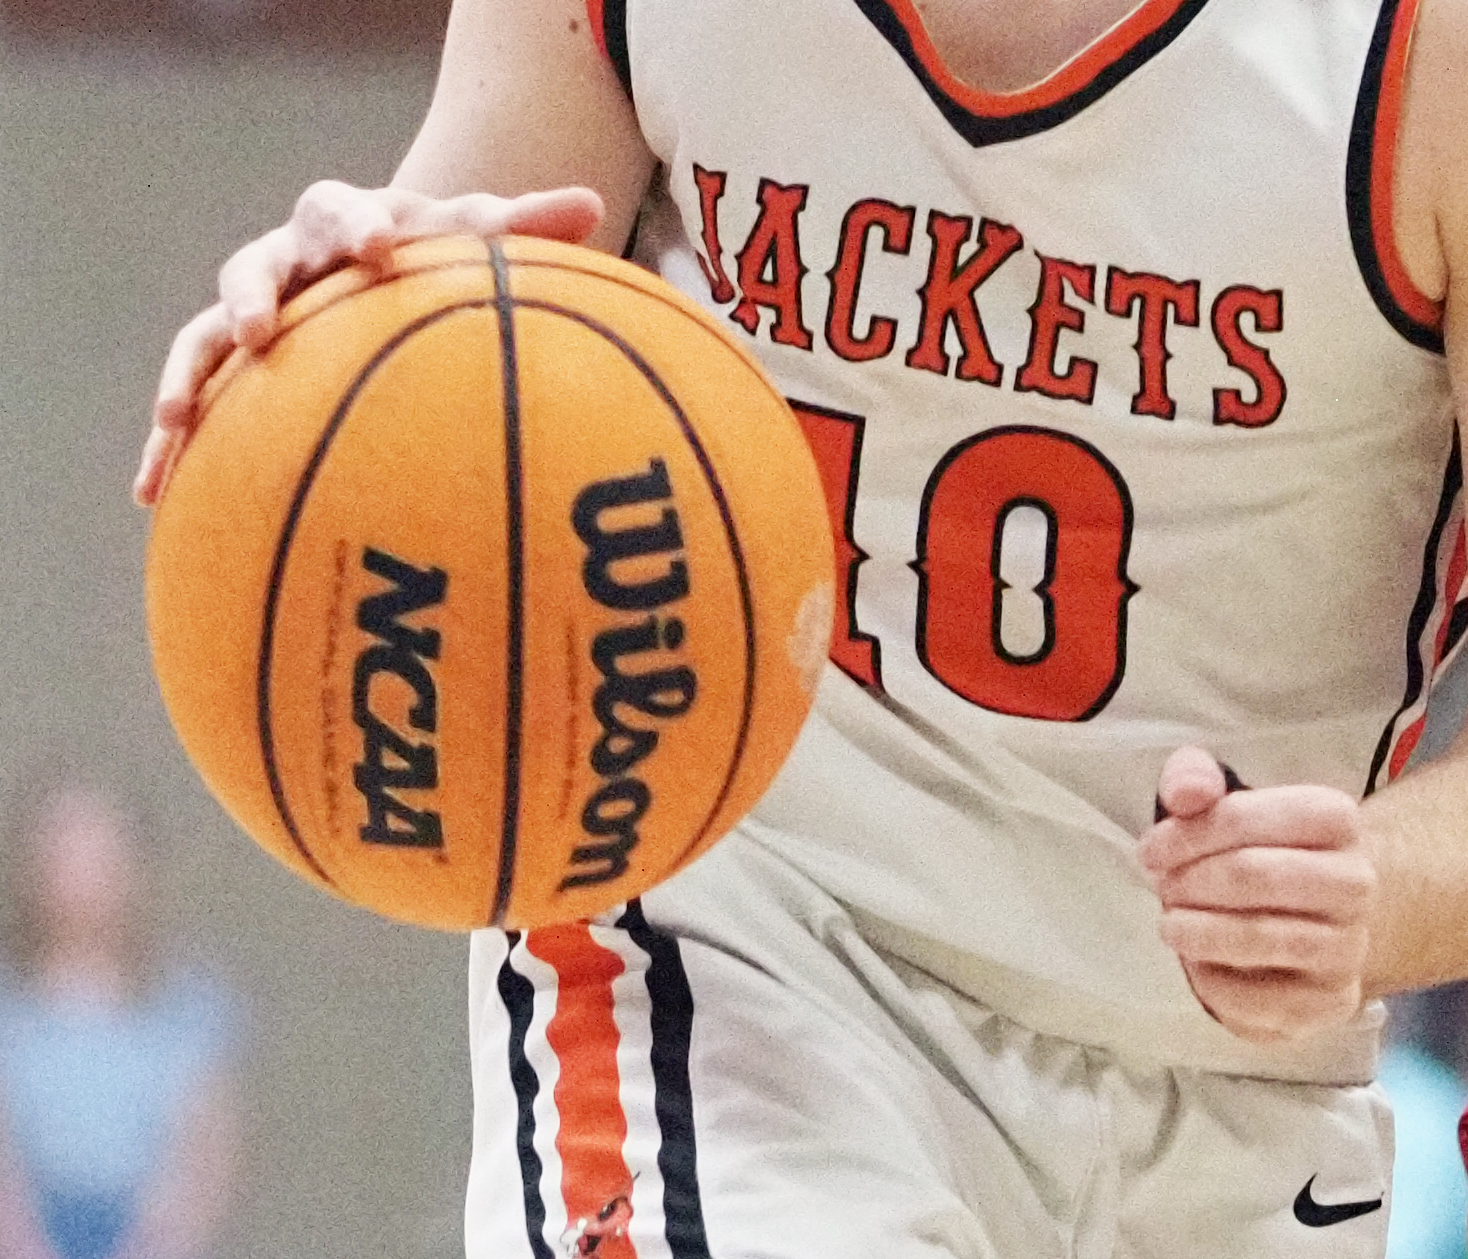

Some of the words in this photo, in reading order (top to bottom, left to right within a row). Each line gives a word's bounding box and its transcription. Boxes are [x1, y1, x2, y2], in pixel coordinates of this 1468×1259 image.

[692, 163, 1287, 428] JACKETS
[351, 545, 450, 851] NCAA
[559, 455, 699, 892] Wilson
